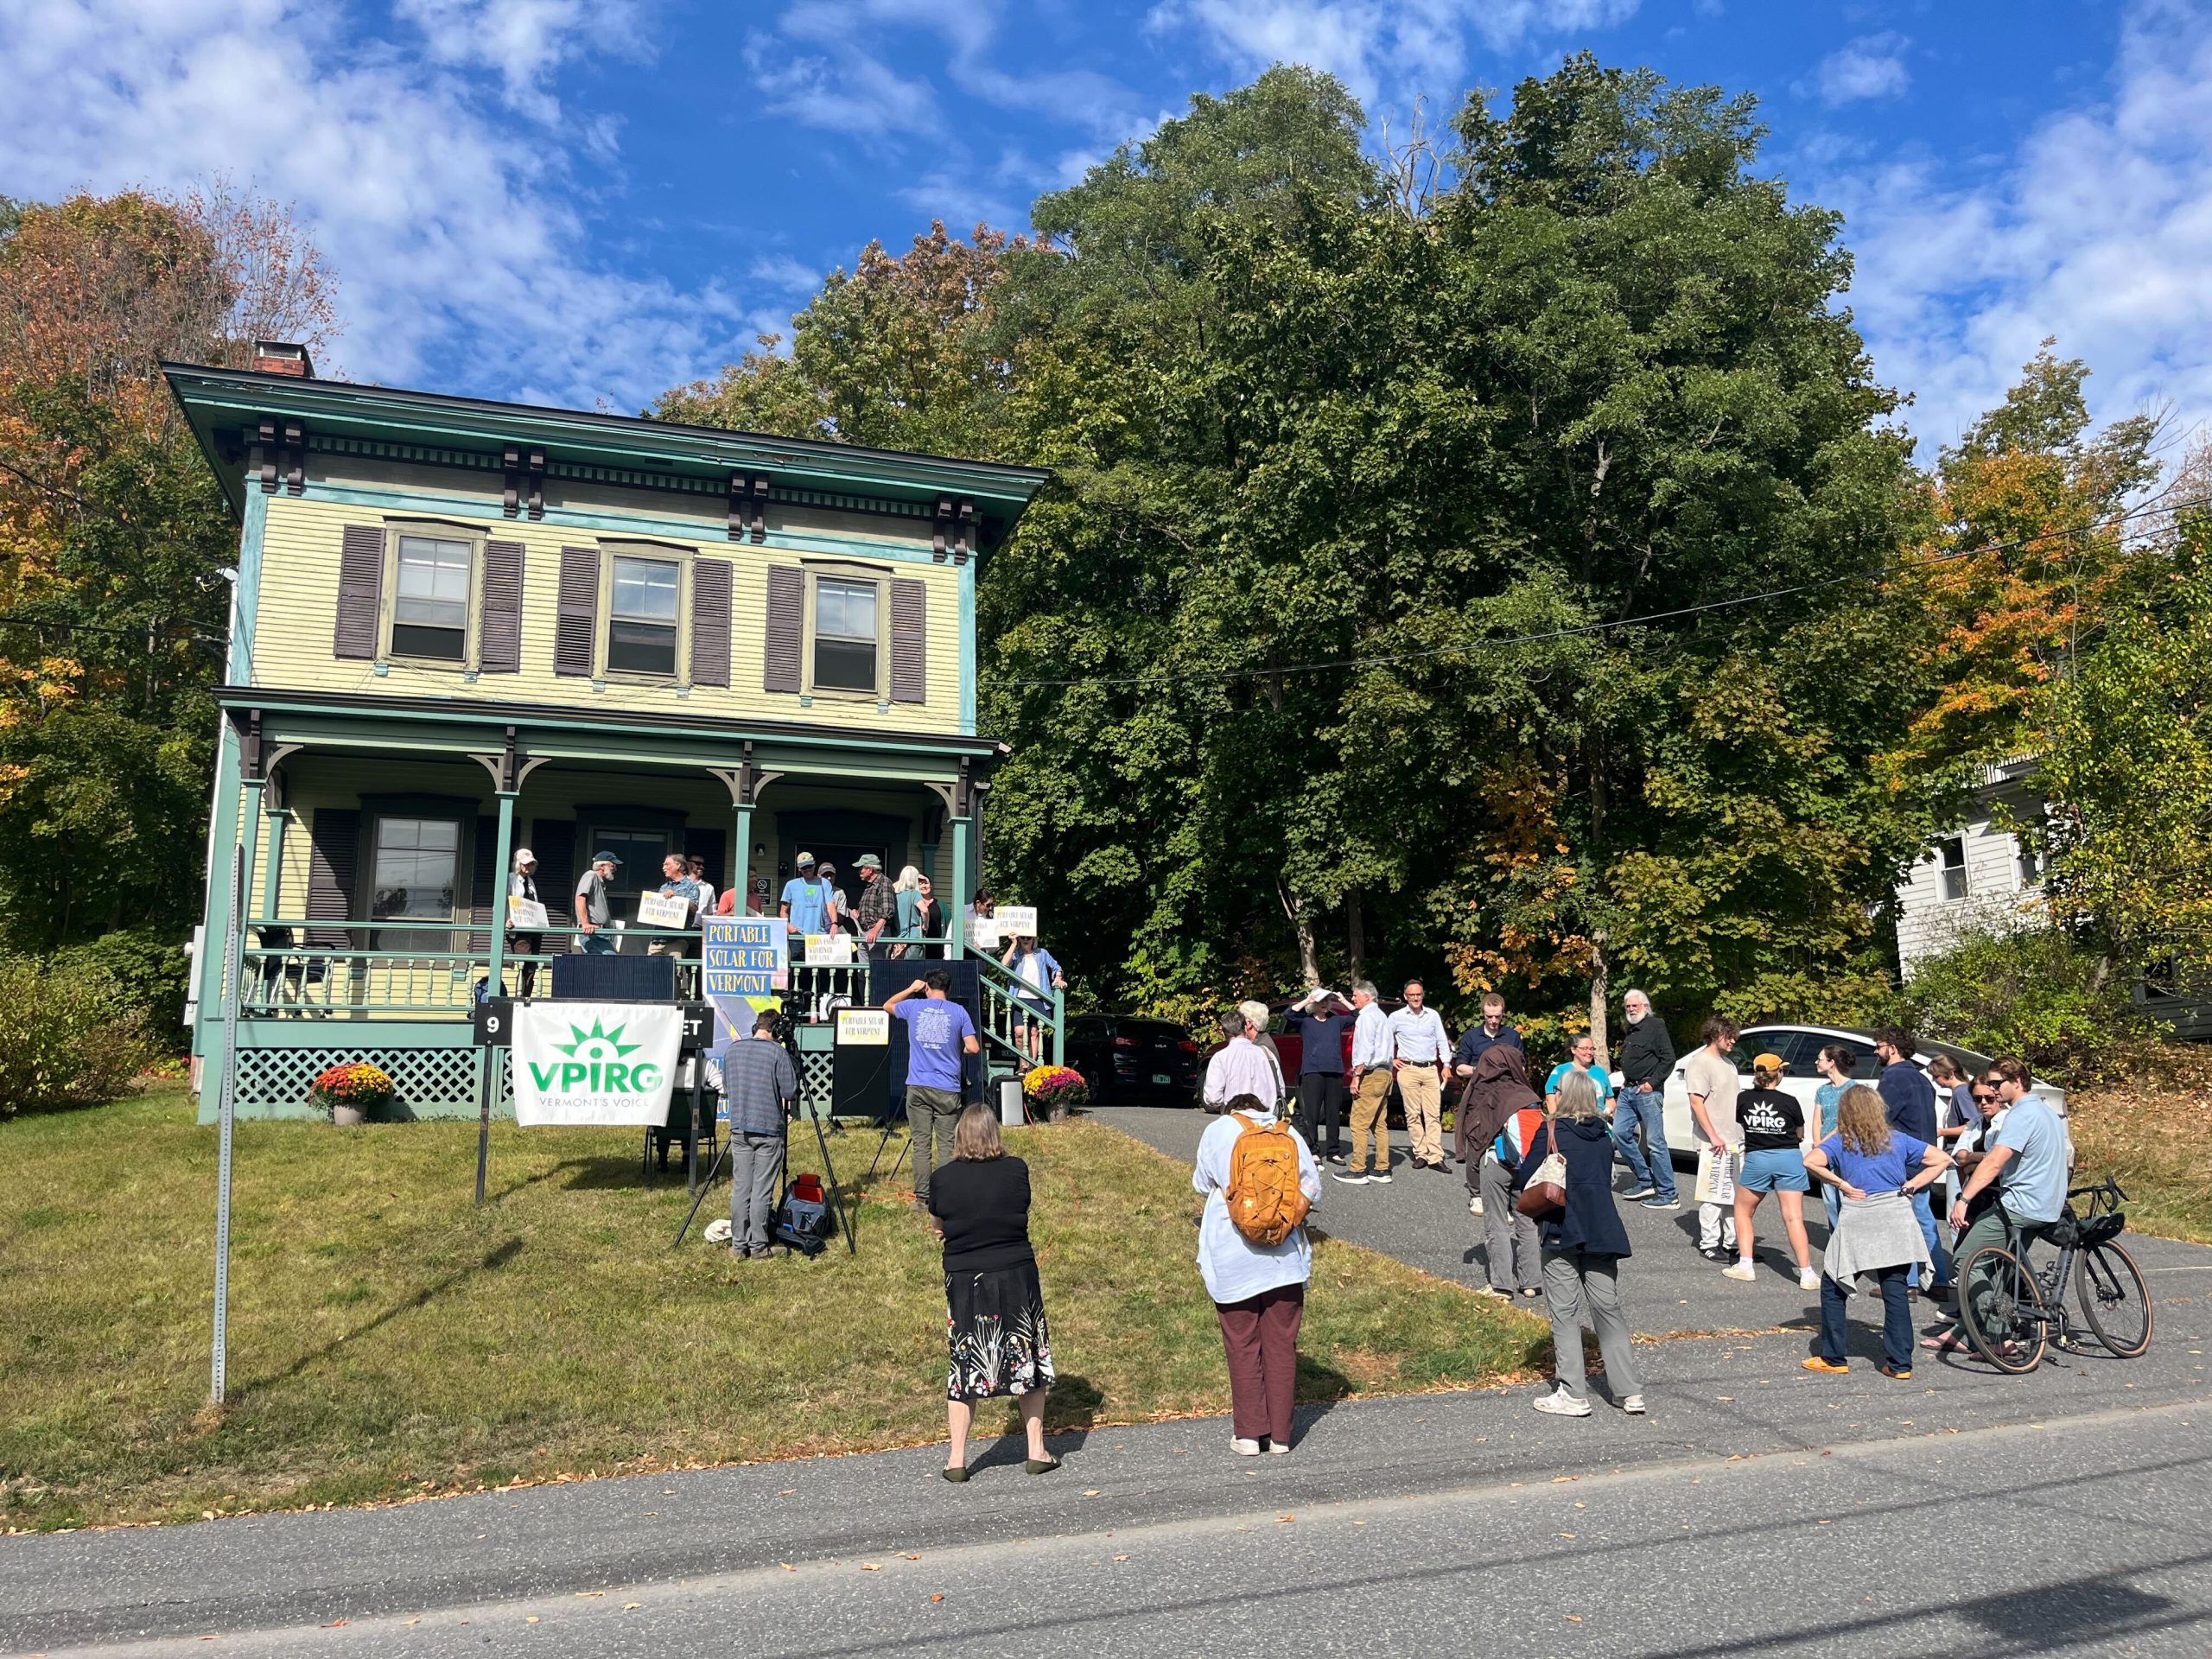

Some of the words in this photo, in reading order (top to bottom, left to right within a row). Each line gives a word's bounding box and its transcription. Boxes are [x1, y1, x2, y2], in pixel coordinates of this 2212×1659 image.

[709, 925, 768, 943] PORTABLE
[709, 950, 747, 968] SOLAR
[751, 950, 774, 968] FOR
[709, 974, 766, 993] VERMONT
[486, 1017, 499, 1033] 9
[842, 1016, 867, 1025] PORTABLE
[539, 1096, 608, 1107] VERMONT'S
[613, 1097, 650, 1107] VOICE
